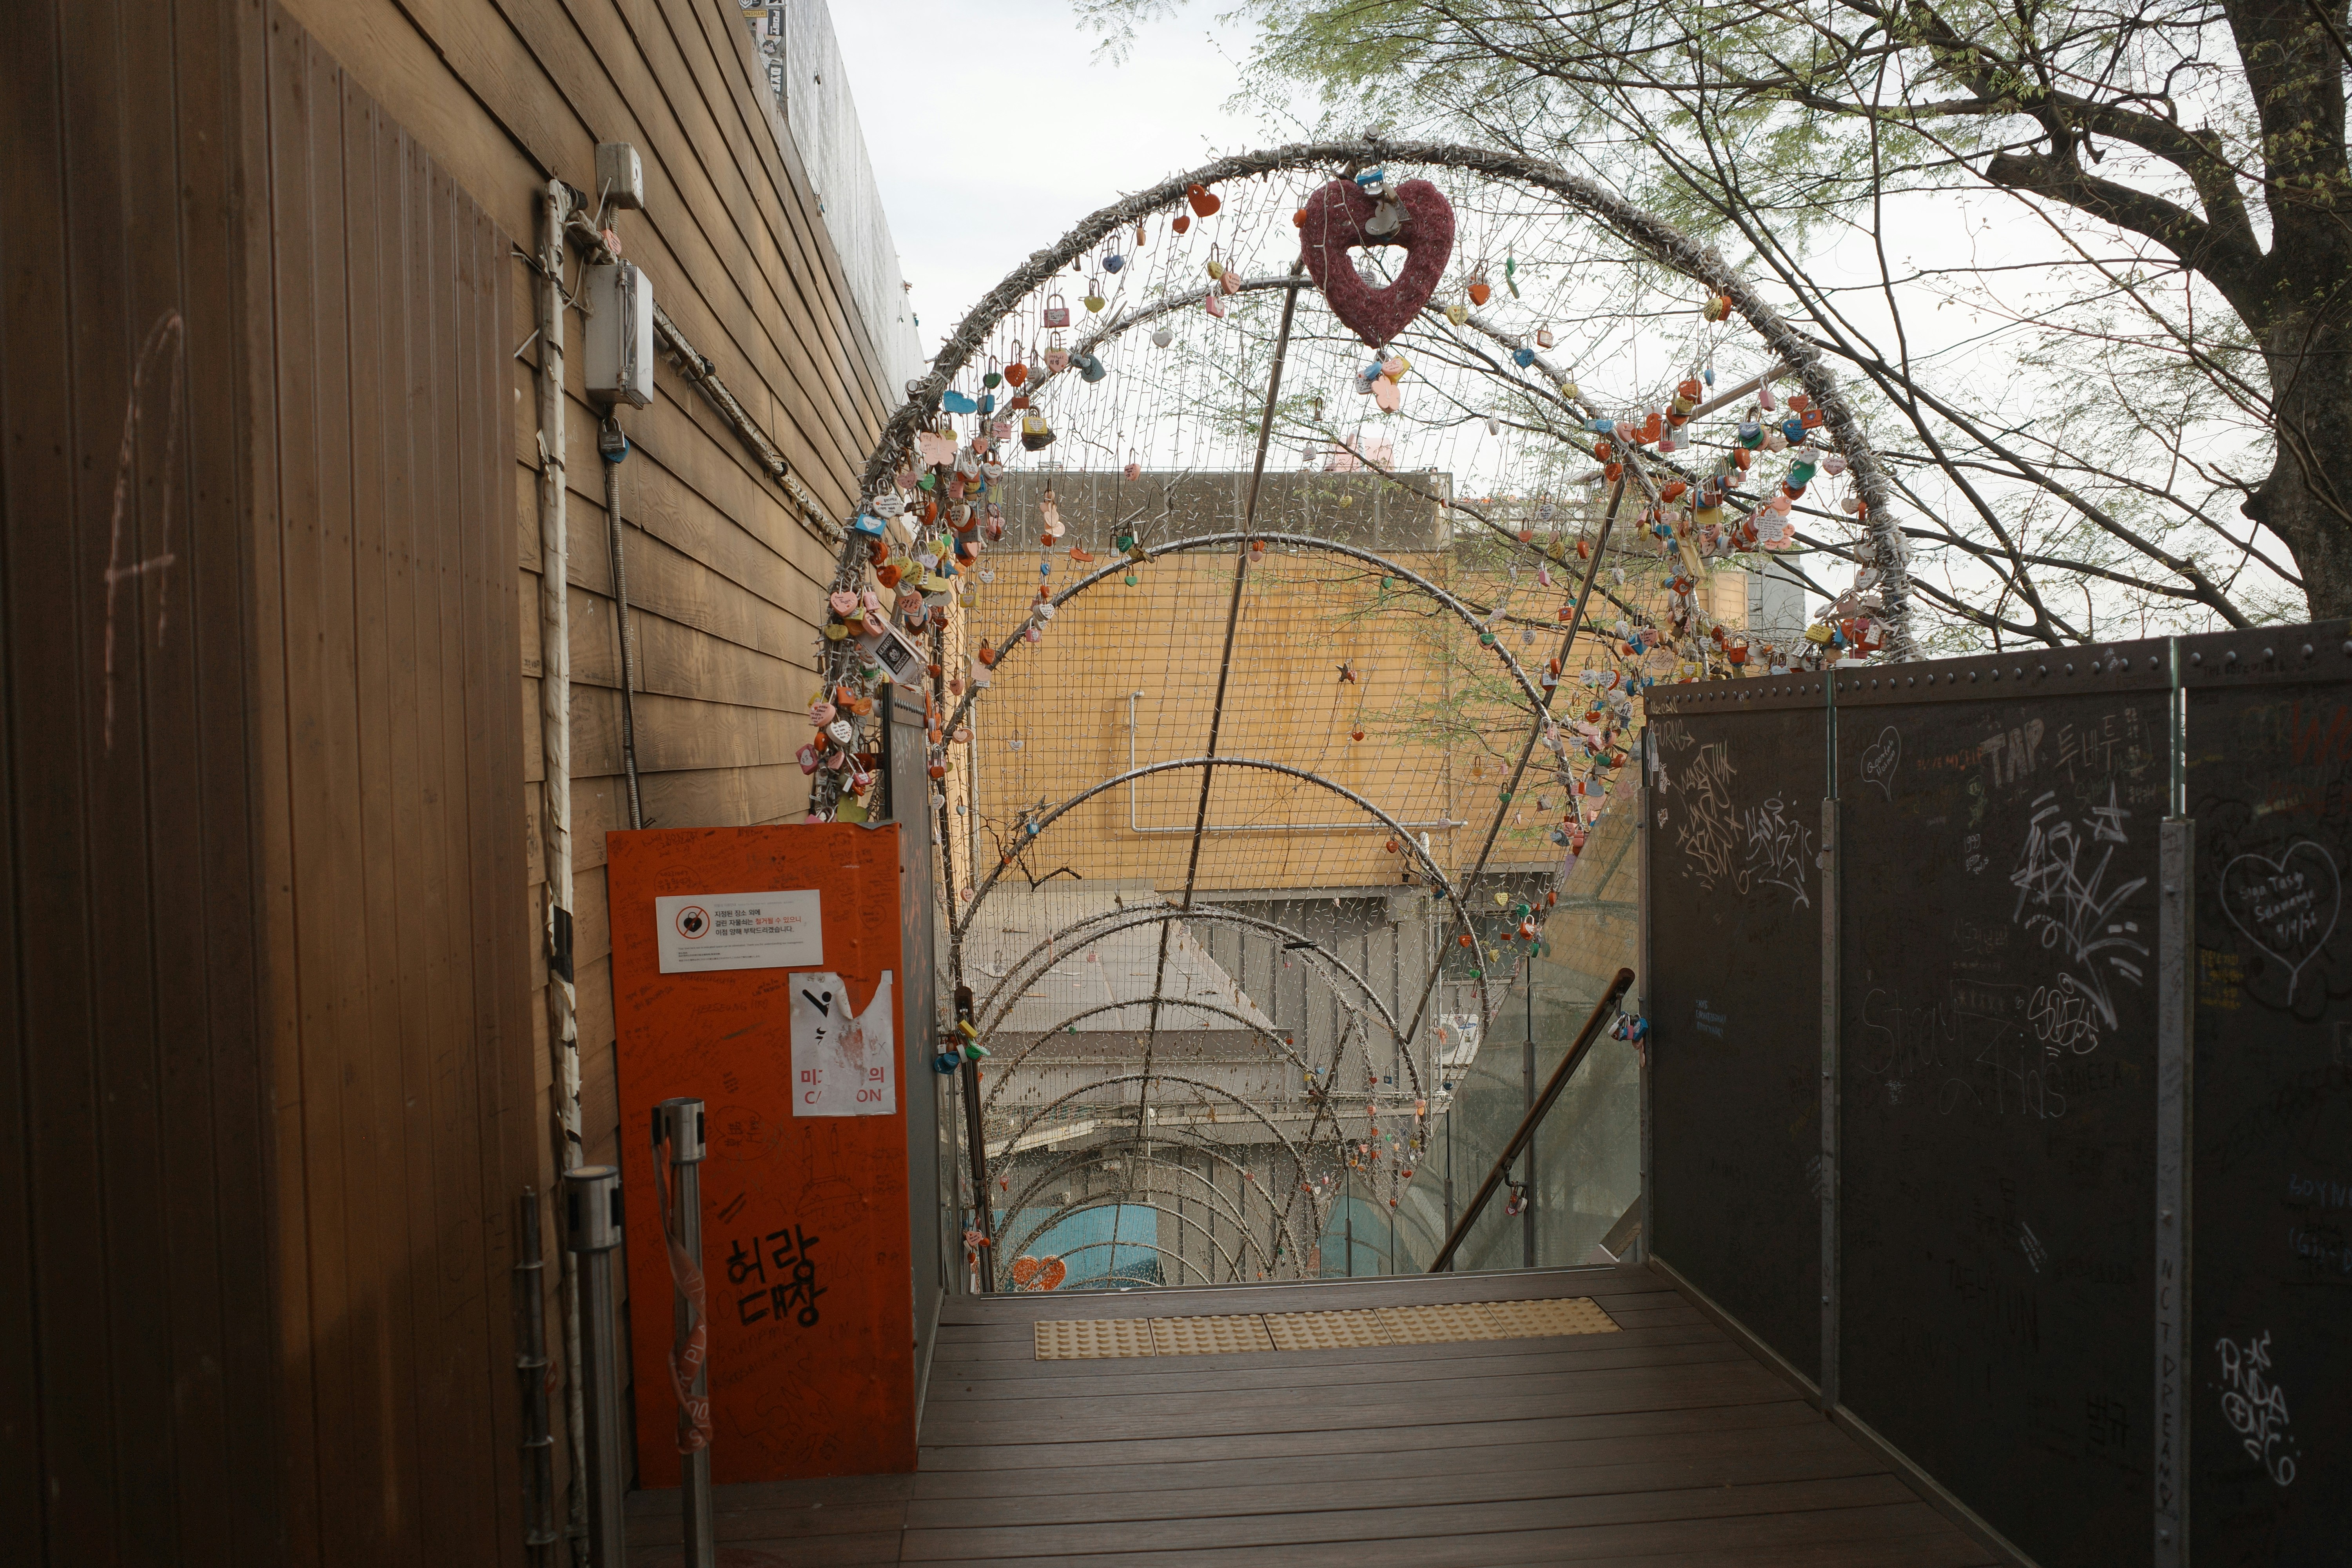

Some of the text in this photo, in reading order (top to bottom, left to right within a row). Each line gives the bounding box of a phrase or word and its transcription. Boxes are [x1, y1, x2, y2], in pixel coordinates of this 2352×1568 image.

[878, 635, 894, 655] TATTOO
[744, 926, 795, 935] 부탁드리겠습니다.
[727, 1223, 820, 1286] 허랑
[737, 1282, 828, 1328] 대장
